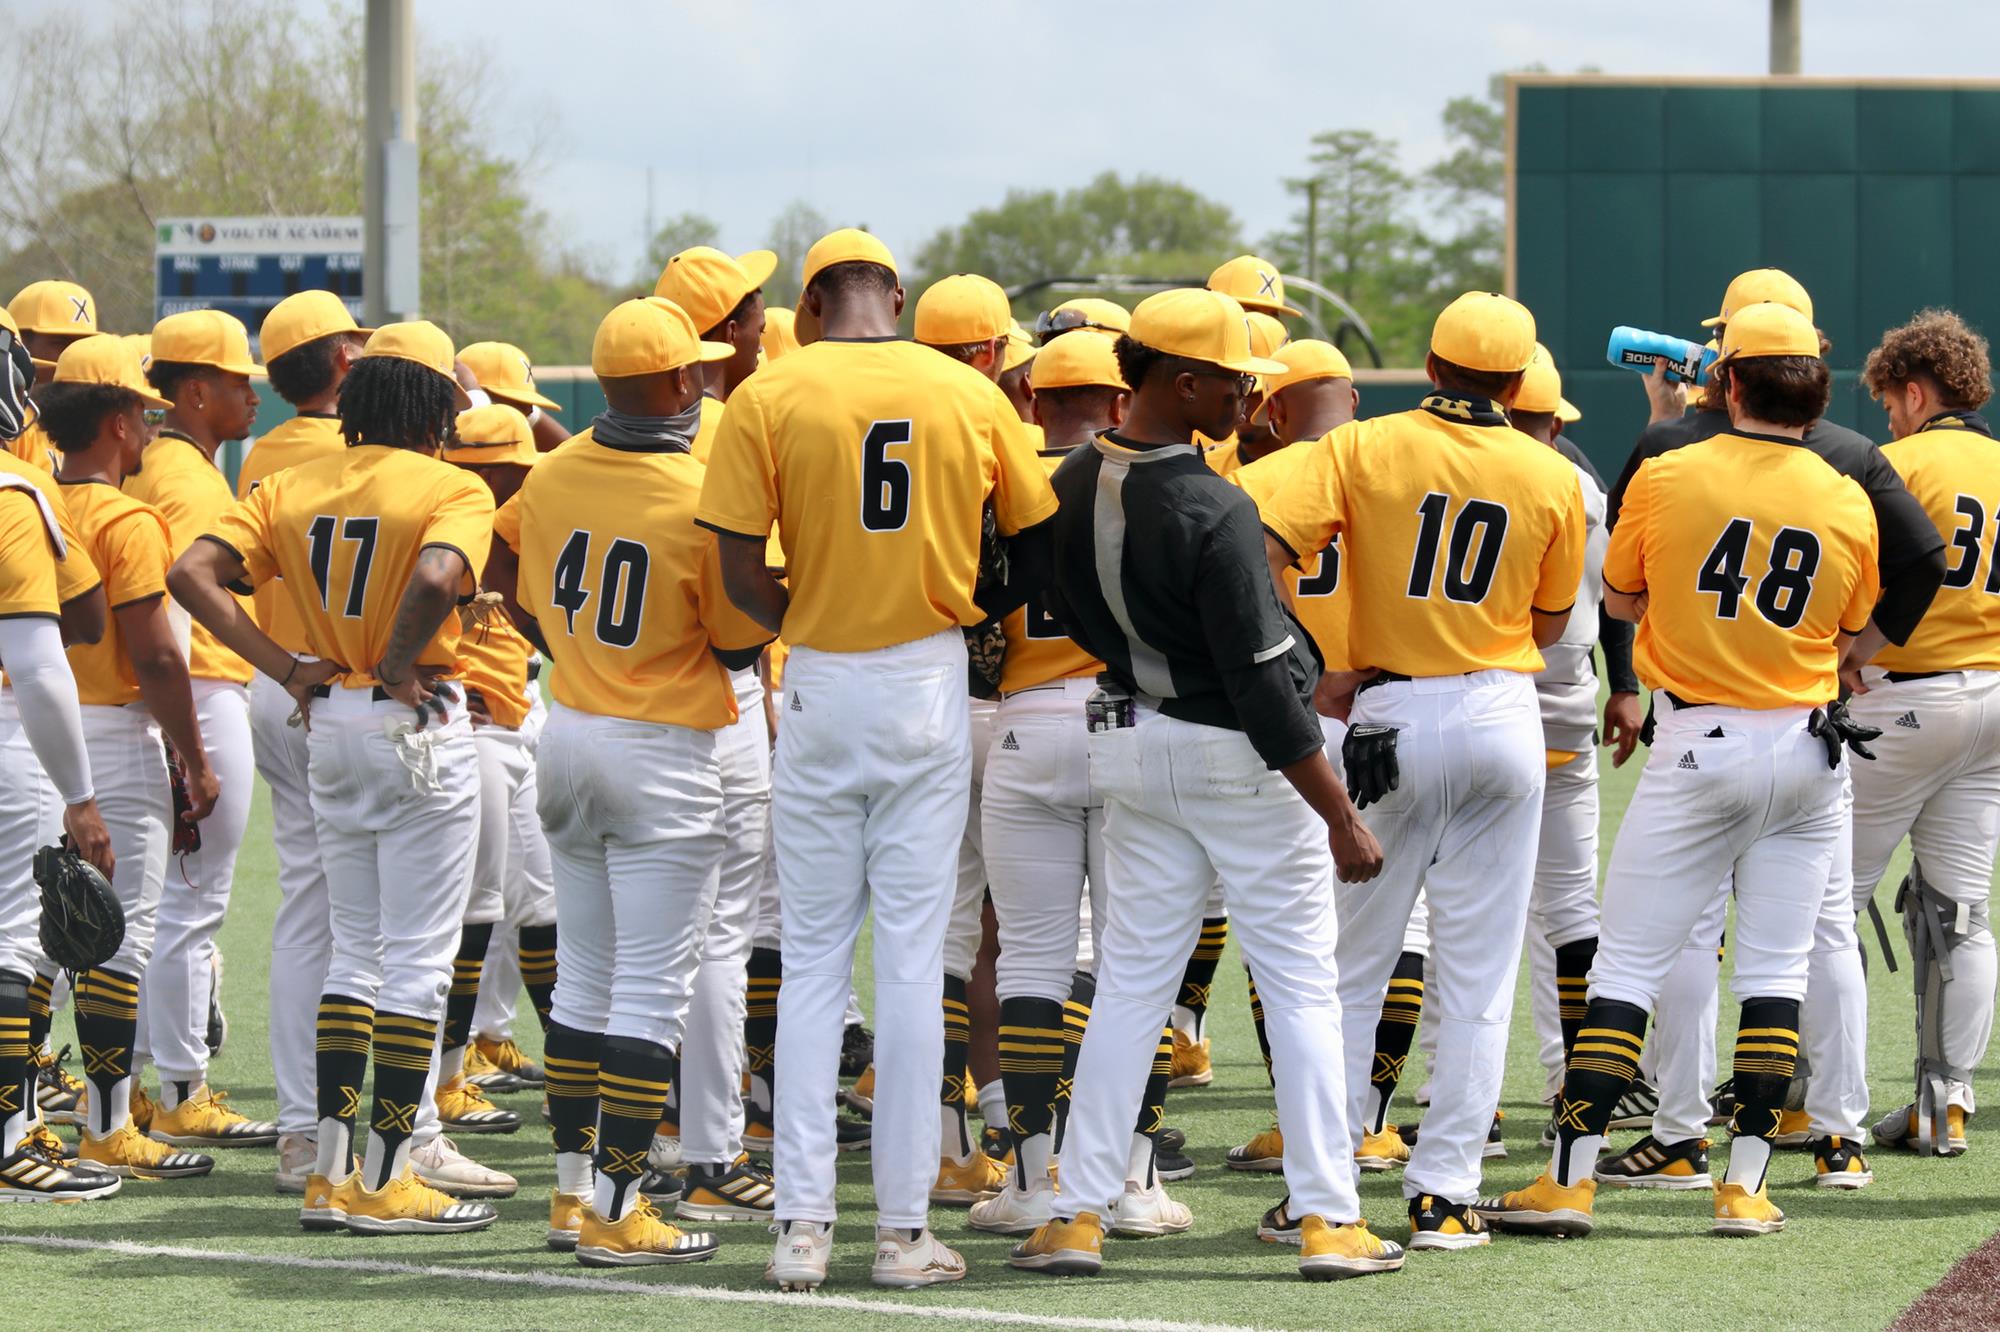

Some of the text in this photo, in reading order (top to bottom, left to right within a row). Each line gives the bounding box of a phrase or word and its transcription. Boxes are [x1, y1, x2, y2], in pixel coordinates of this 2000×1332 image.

[220, 227, 361, 240] YOUTH ACADEM
[279, 255, 304, 271] OUT
[1625, 351, 1697, 378] POWADE
[860, 418, 912, 532] 6
[305, 514, 380, 619] 17
[1405, 491, 1510, 606] 10
[1696, 516, 1822, 630] 48
[551, 528, 651, 649] 40
[1895, 719, 1920, 729] adidas
[1677, 761, 1699, 770] adidas
